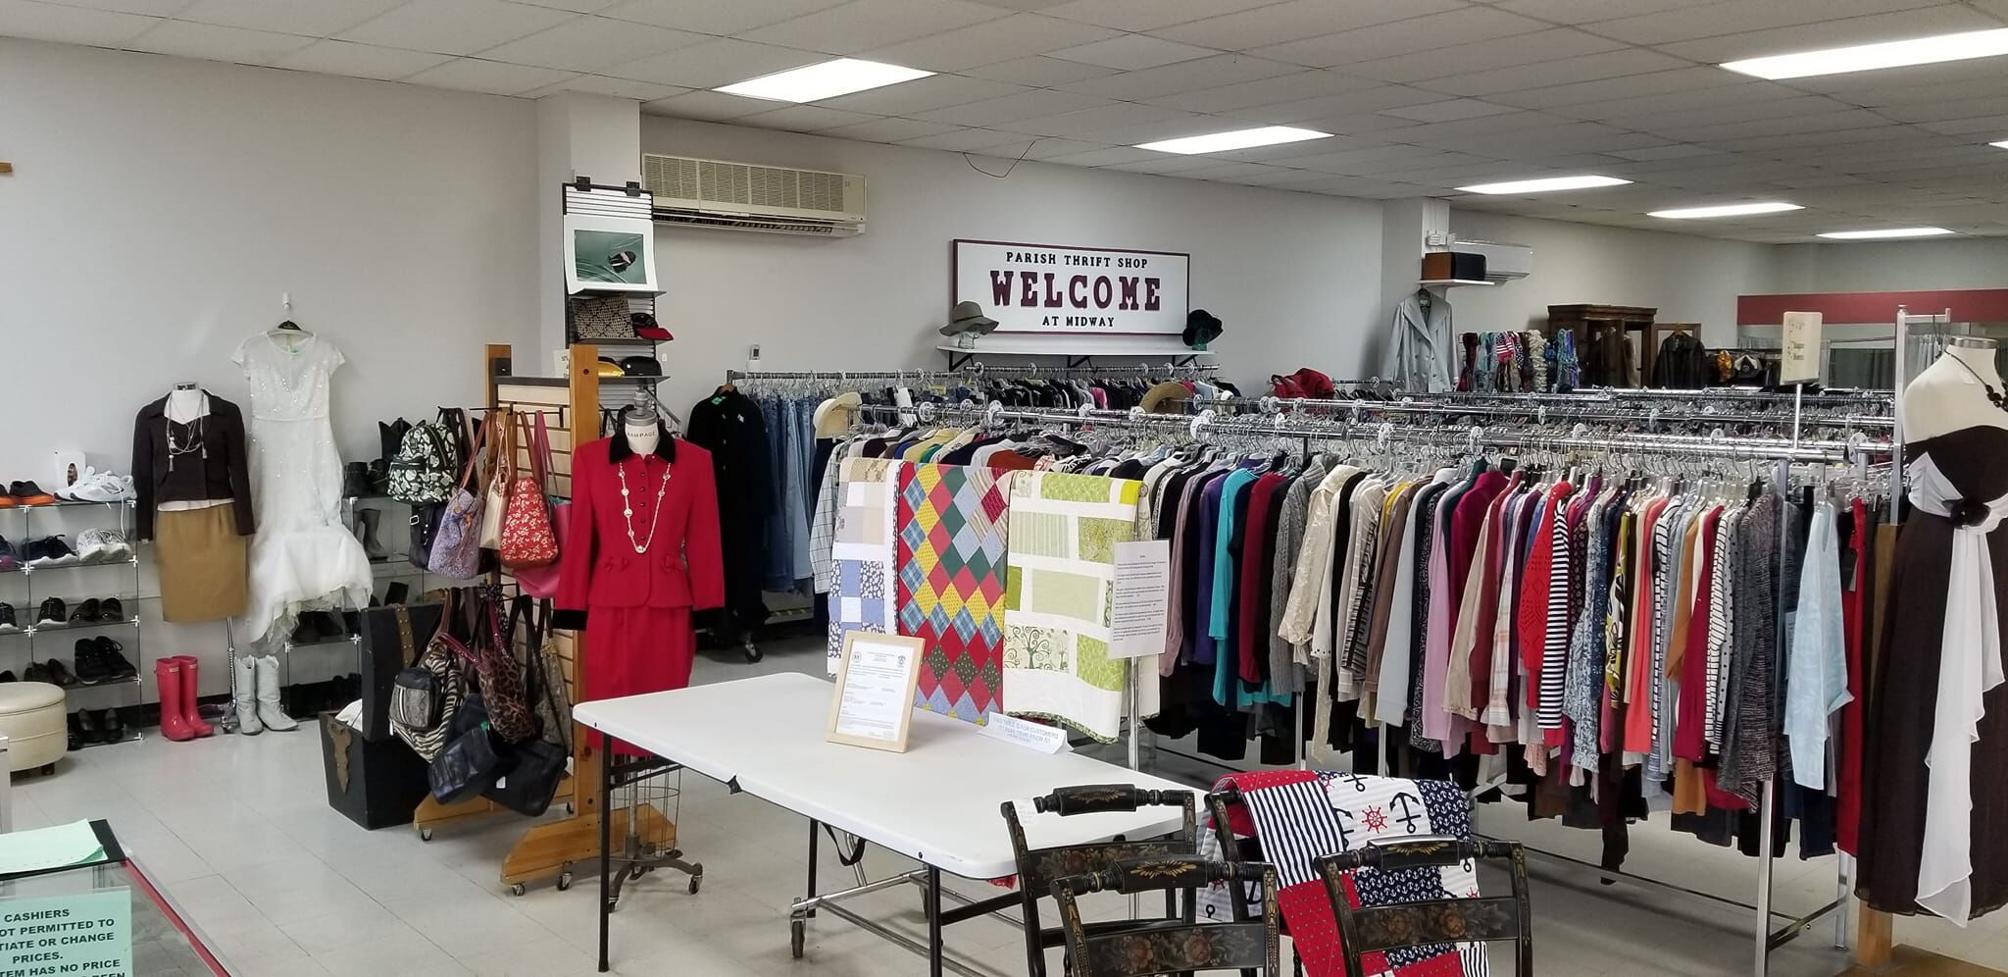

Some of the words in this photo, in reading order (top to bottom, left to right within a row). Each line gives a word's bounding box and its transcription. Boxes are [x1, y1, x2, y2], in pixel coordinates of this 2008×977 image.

[1006, 251, 1056, 264] PARISH
[1064, 255, 1111, 267] THRIFT
[1117, 257, 1148, 269] SHOP
[990, 270, 1160, 311] WELCOME
[1042, 316, 1059, 326] AT
[1066, 316, 1115, 328] MIDWAY
[4, 909, 70, 923] CASHIERS
[20, 920, 94, 935] PERMITTED
[98, 918, 115, 928] TO
[38, 938, 57, 947] OR
[61, 932, 115, 945] CHANGE
[12, 951, 64, 964] PRICES.
[29, 965, 56, 976] HAS
[60, 963, 79, 973] NO
[82, 959, 121, 971] PRICE
